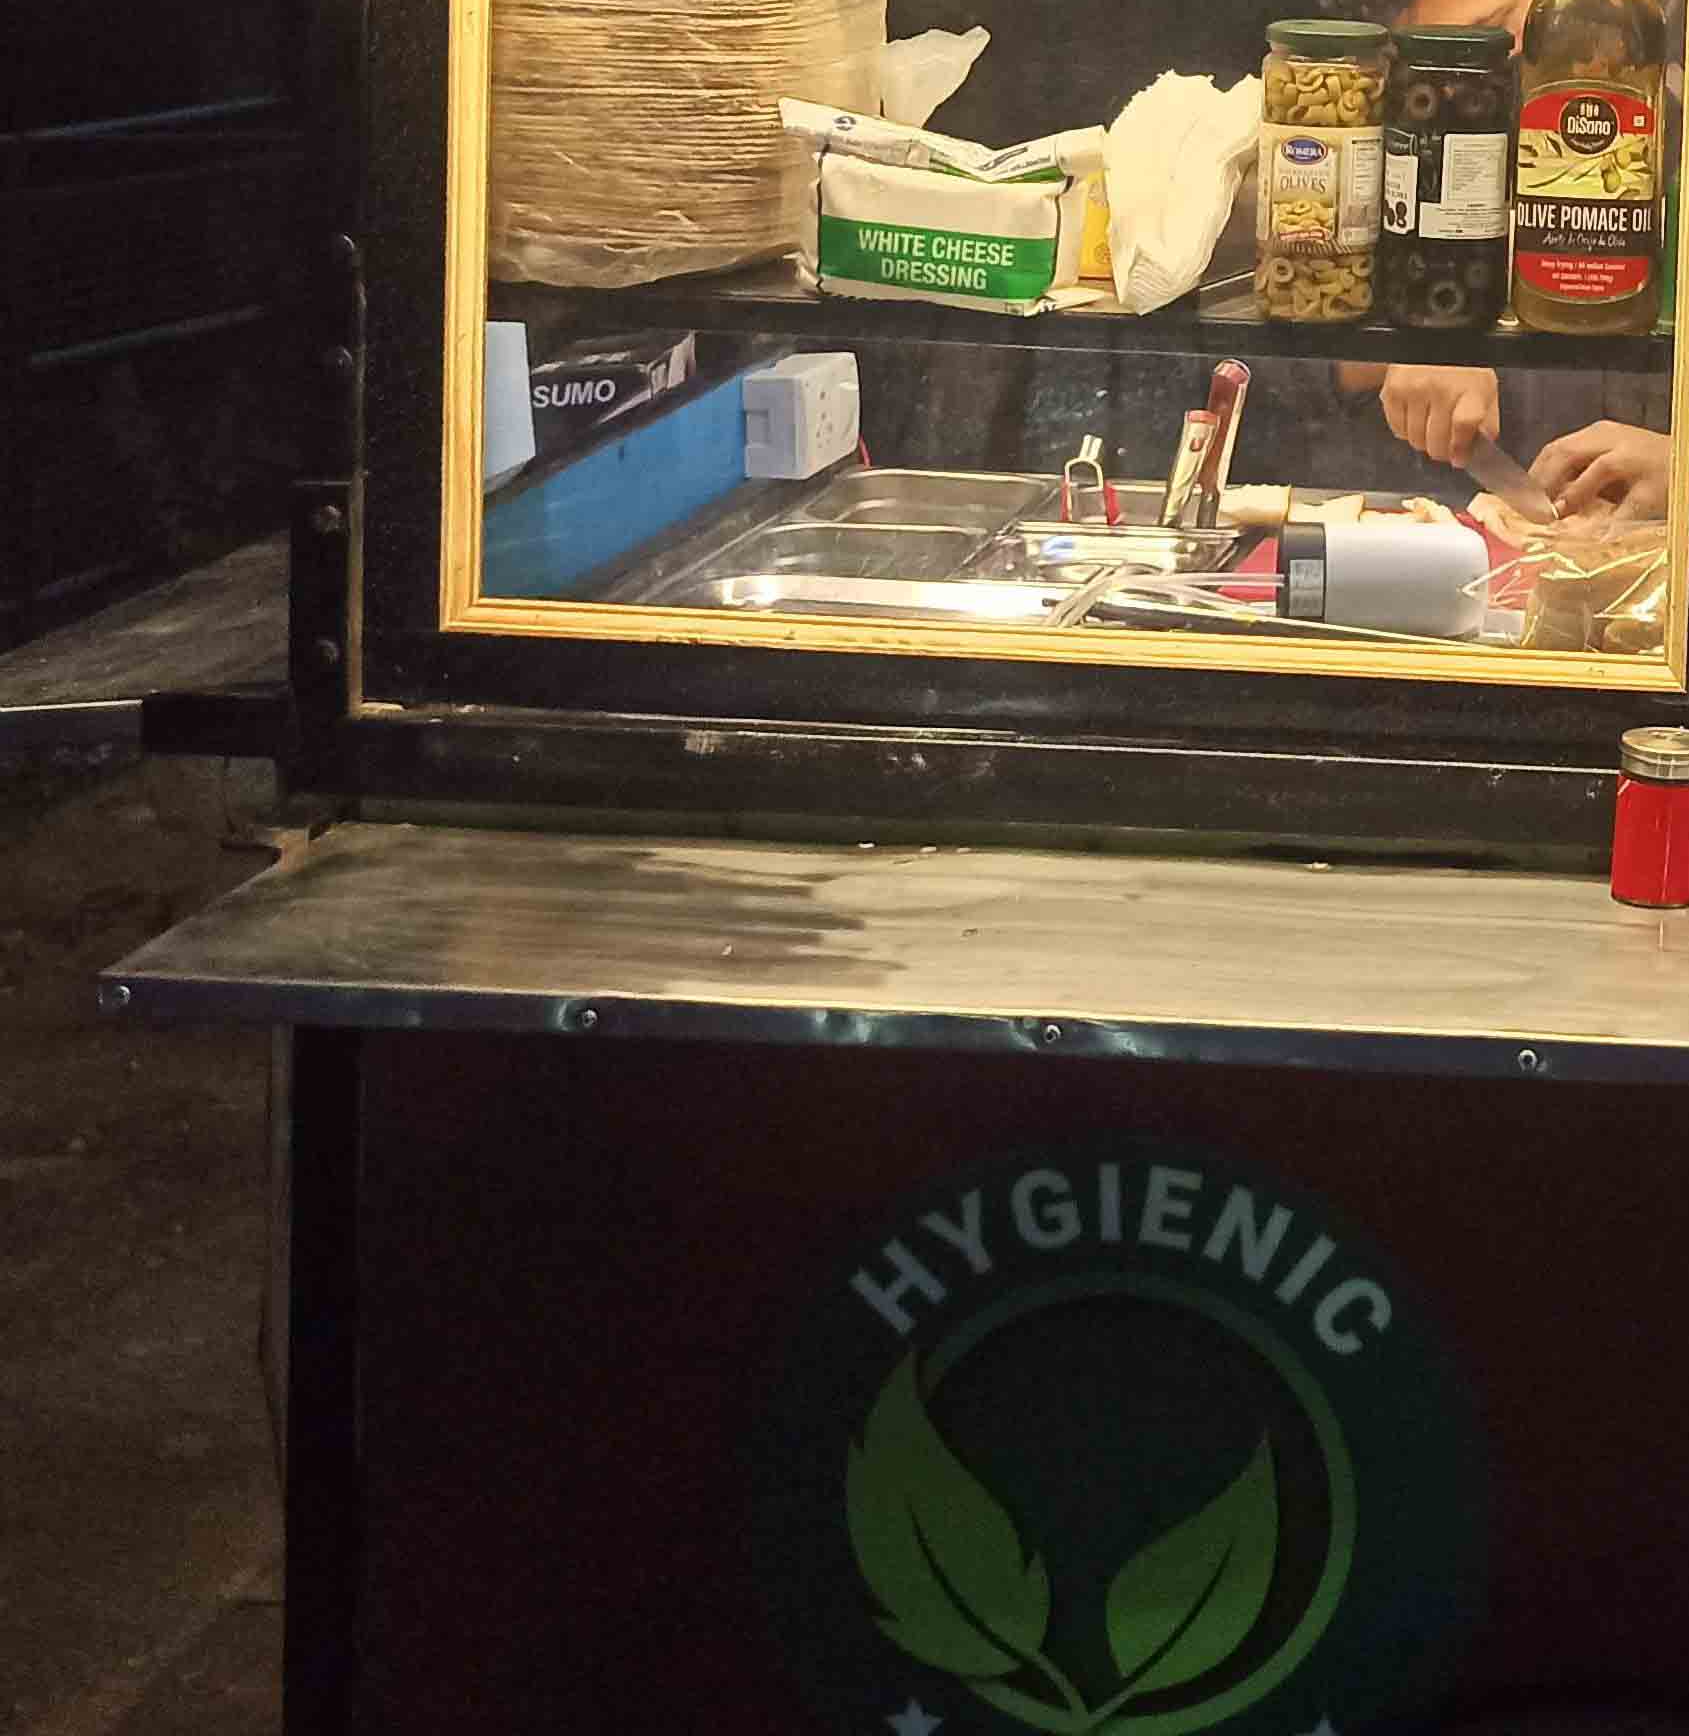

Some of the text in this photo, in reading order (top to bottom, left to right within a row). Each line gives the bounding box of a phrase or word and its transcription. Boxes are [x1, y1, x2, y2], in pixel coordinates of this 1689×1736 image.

[1279, 175, 1327, 194] OLIVES
[1517, 201, 1653, 233] OLIVE POMACE OIL
[858, 228, 1017, 267] WHITE CHEESE
[880, 258, 988, 291] DRESSING
[532, 378, 616, 408] SUMO
[849, 1161, 1394, 1355] HYGIENIC
